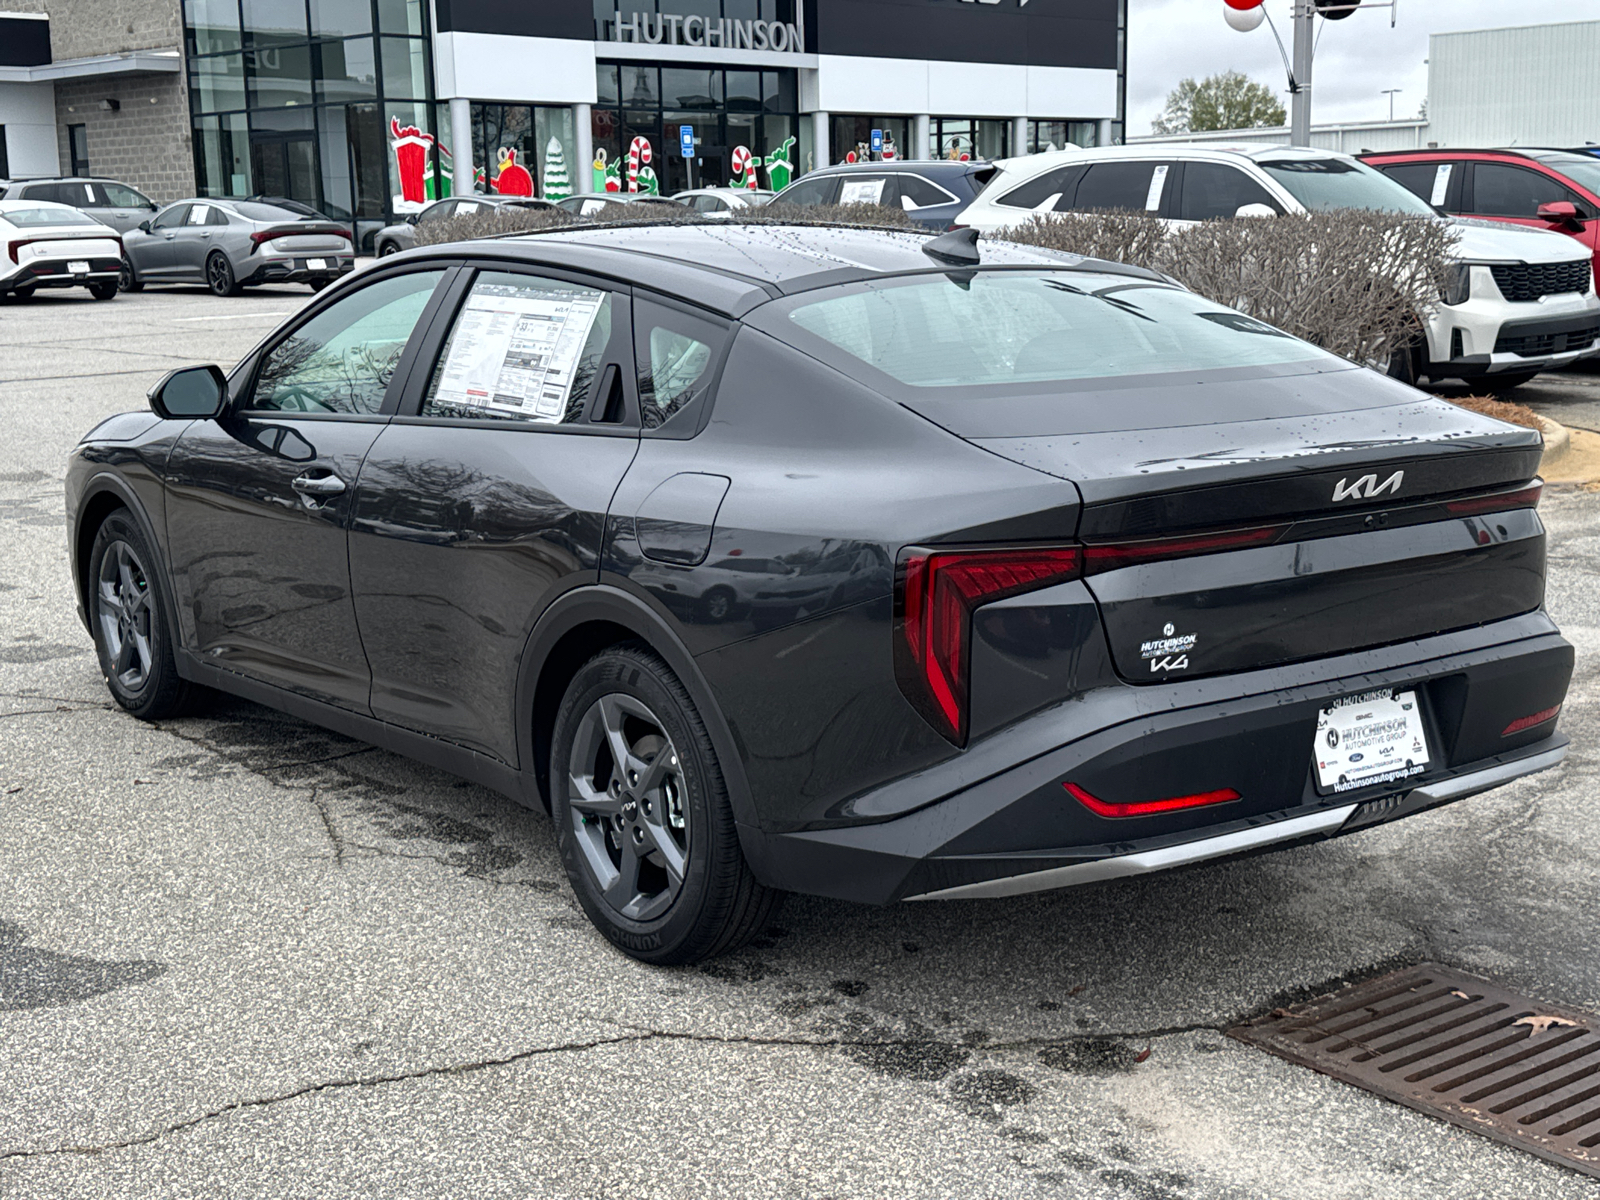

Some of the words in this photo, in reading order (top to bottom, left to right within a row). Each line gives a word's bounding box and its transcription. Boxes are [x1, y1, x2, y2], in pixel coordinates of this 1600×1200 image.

[615, 11, 804, 53] HUTCHINSON
[1332, 470, 1404, 502] KIA
[1140, 634, 1197, 651] HUTCHINSON
[1150, 654, 1189, 673] K4
[1343, 688, 1393, 706] HUTCHINSON
[1341, 717, 1407, 742] HUTCHINSON
[1345, 735, 1385, 751] AUTOMOTIVE
[1386, 731, 1406, 742] GROUP
[1334, 765, 1425, 792] Hutchinsonautogroup.com
[610, 927, 661, 950] KUMHO
